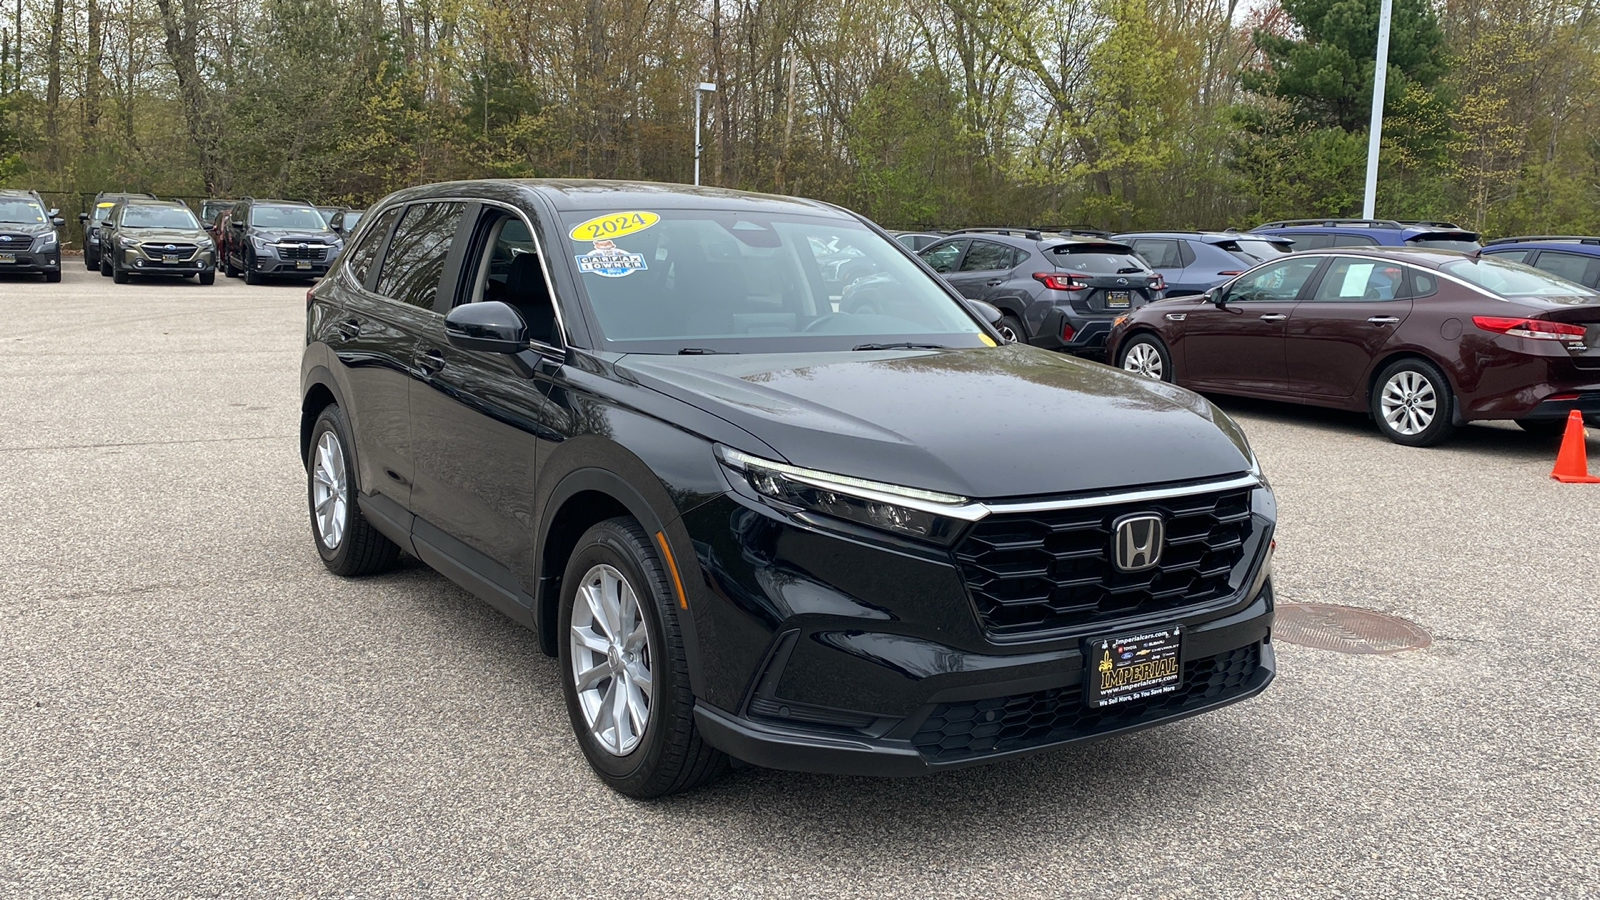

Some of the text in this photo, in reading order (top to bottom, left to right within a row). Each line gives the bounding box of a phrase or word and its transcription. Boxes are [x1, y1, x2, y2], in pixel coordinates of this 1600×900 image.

[587, 213, 646, 238] 2024
[1100, 675, 1178, 695] www.imperialcars.com
[1101, 657, 1178, 689] IMPERIAL
